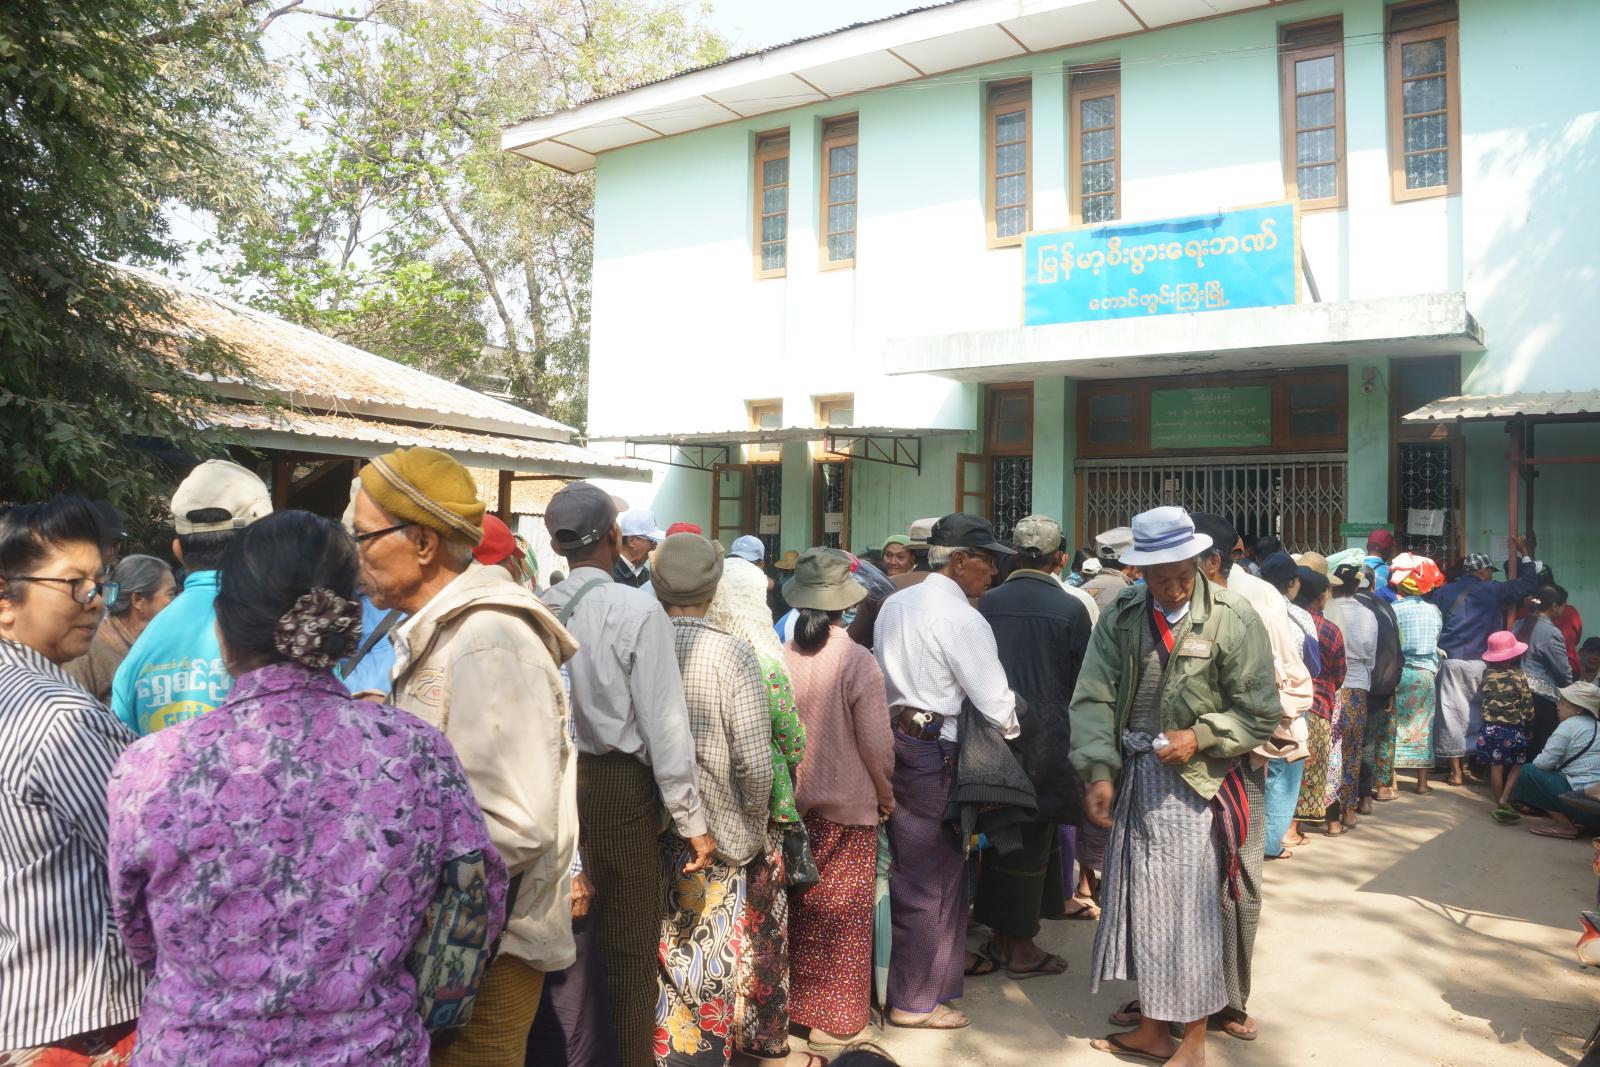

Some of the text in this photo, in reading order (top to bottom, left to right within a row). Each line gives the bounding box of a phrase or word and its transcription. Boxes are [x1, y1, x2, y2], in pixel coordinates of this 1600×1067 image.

[1037, 217, 1278, 284] မြန်မာ့စီးပွားရေးဘဏ်
[1089, 280, 1230, 313] တောင်တွင်းကြီးမြို့
